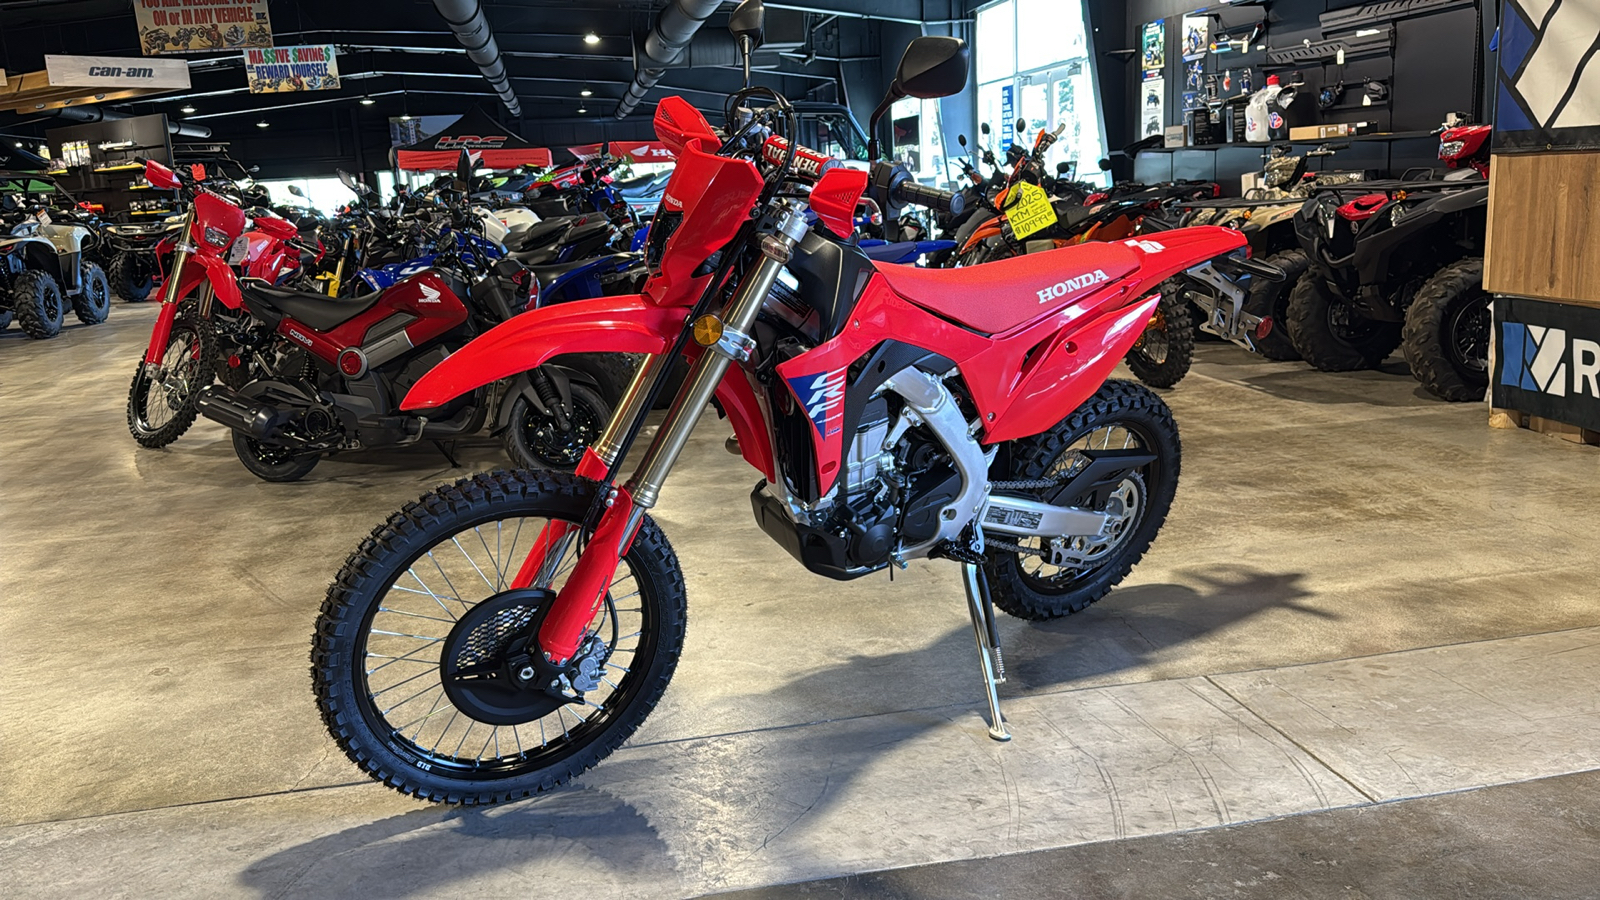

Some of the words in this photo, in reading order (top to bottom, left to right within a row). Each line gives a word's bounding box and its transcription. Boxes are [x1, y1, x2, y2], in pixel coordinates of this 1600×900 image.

[153, 10, 168, 26] ON
[169, 12, 180, 25] or
[181, 9, 193, 25] IN
[193, 8, 213, 24] ANY
[214, 6, 254, 23] VEHICLE
[255, 64, 290, 79] REWARD
[290, 63, 328, 78] YOURSELF
[435, 135, 508, 148] HRC
[664, 193, 683, 208] HONDA
[1016, 189, 1043, 210] 2025
[1010, 208, 1030, 223] KTM
[1036, 269, 1109, 304] HONDA
